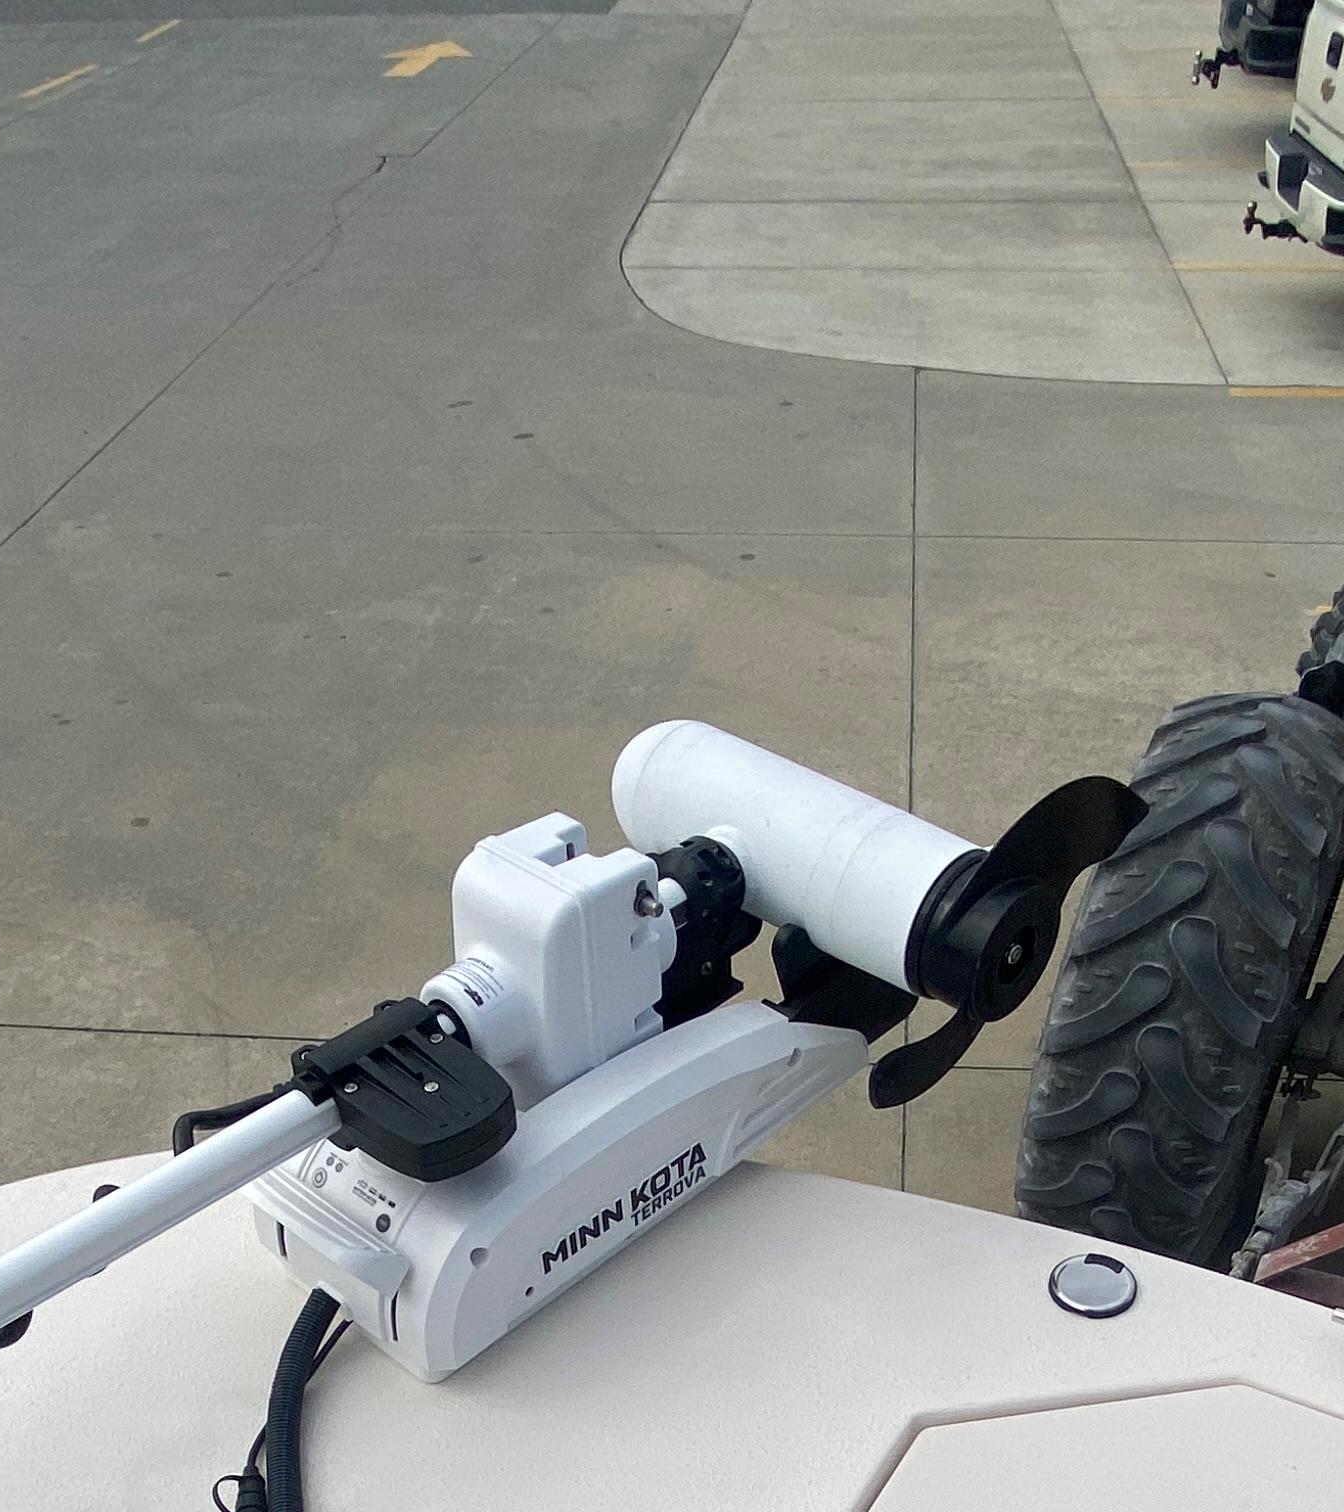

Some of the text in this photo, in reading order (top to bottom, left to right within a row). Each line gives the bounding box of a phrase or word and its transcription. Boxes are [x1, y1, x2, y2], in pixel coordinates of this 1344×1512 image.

[542, 1142, 707, 1275] MINN KOTA
[631, 1165, 706, 1227] TERROVA
